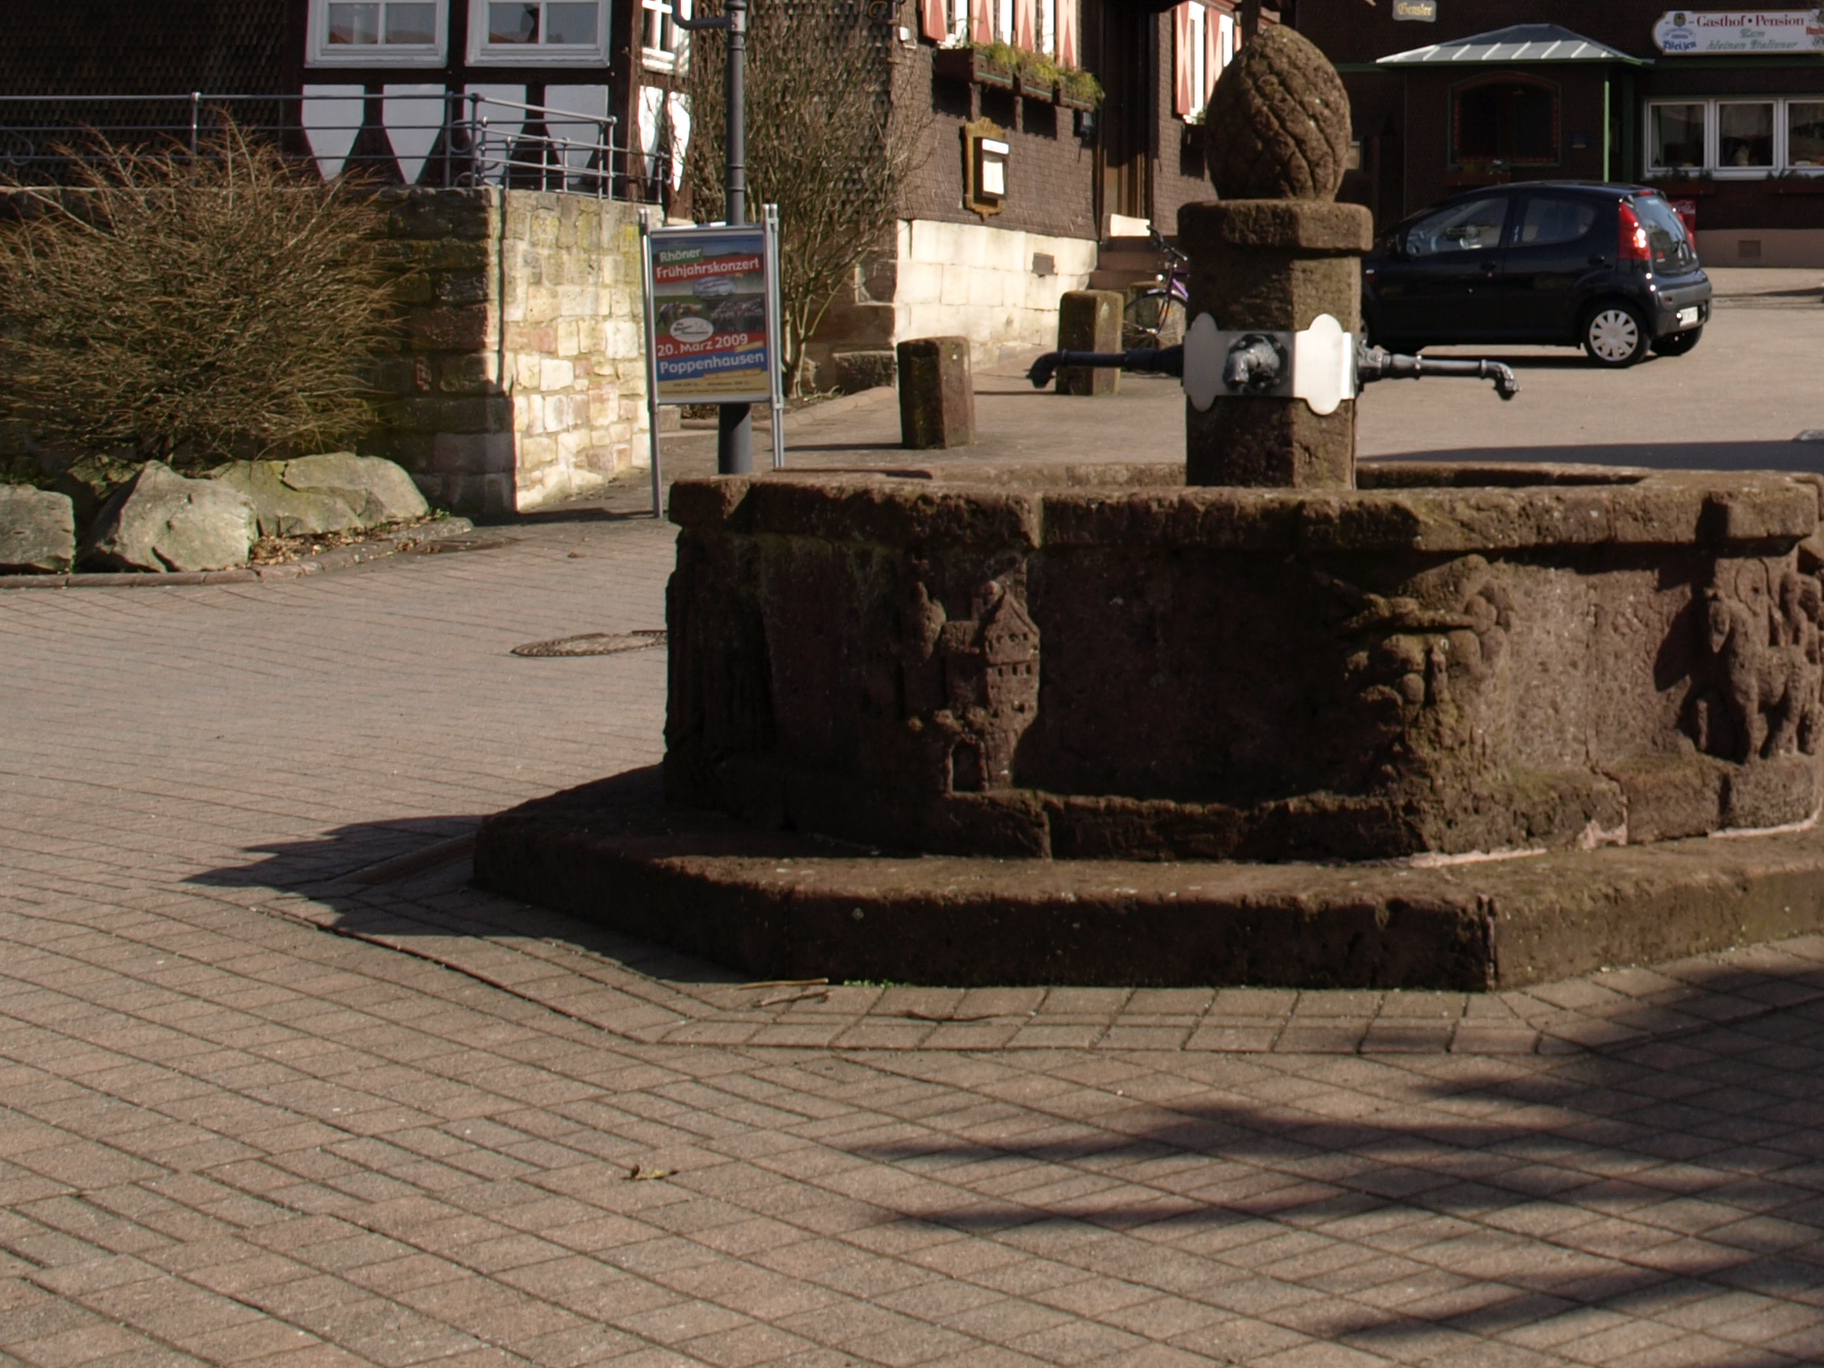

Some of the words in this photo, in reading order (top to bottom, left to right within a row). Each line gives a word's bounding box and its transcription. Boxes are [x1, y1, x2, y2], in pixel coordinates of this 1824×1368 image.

[1696, 15, 1746, 27] Gasthof
[1756, 14, 1804, 27] Pension
[659, 248, 701, 263] Rhöner
[656, 257, 760, 279] Frühjahrskonzert
[657, 343, 678, 357] 20.
[715, 332, 749, 349] 2009
[660, 352, 765, 375] Poppenhausen
